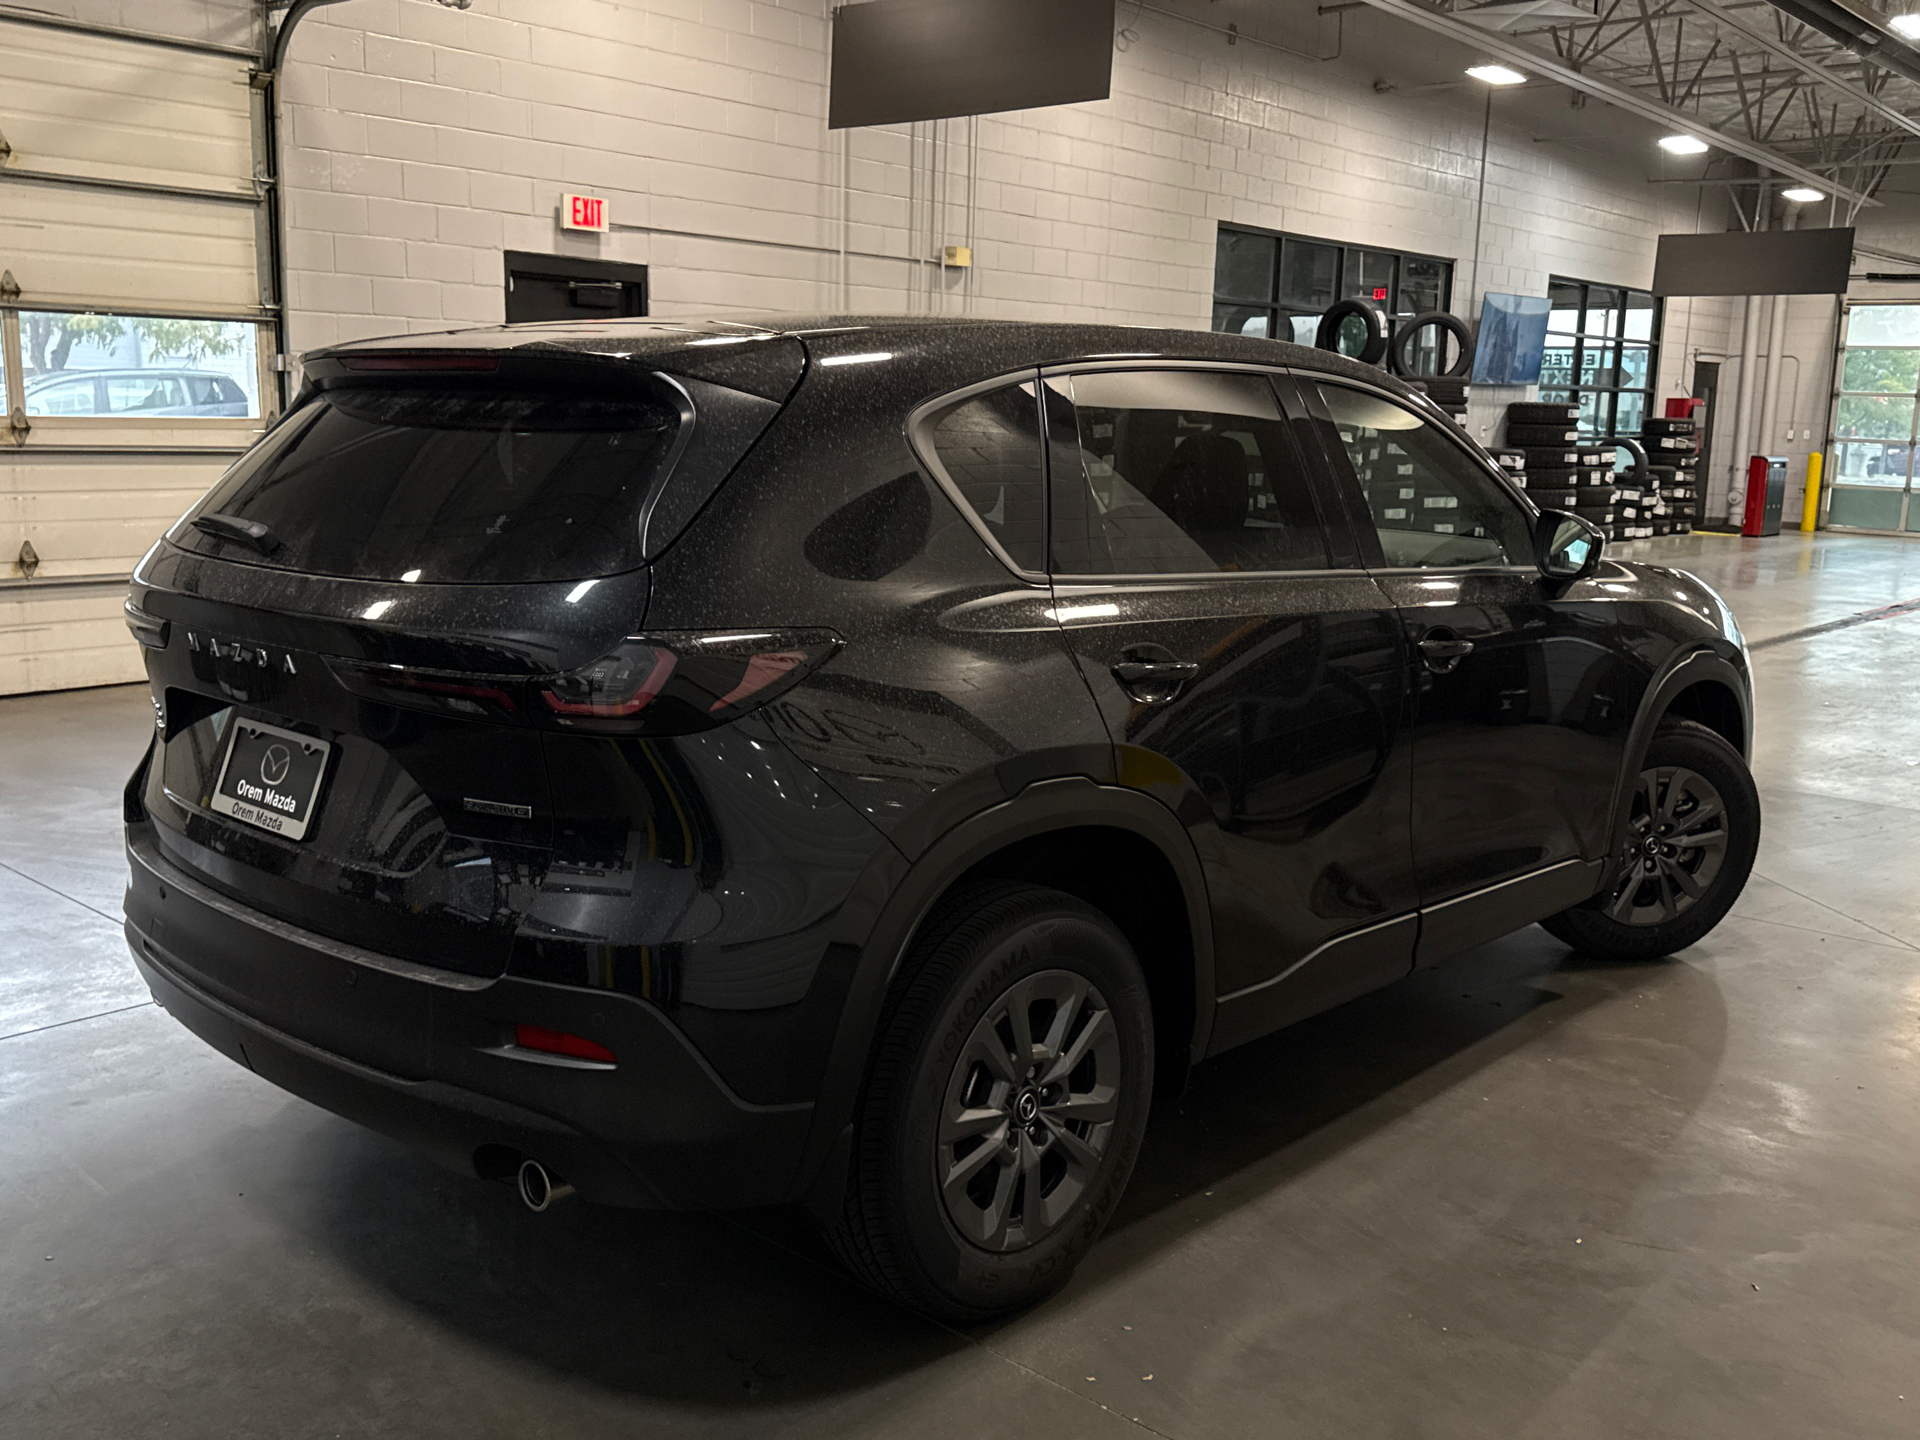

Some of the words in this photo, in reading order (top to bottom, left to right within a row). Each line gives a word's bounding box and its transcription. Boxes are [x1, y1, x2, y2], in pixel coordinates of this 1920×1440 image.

[572, 196, 603, 229] EXIT
[187, 632, 297, 674] MAZDA
[237, 779, 263, 799] Orem
[264, 788, 297, 813] Mazda
[231, 802, 254, 821] Orem
[254, 810, 283, 831] Mazda
[935, 943, 1031, 1065] YOKOHAMA
